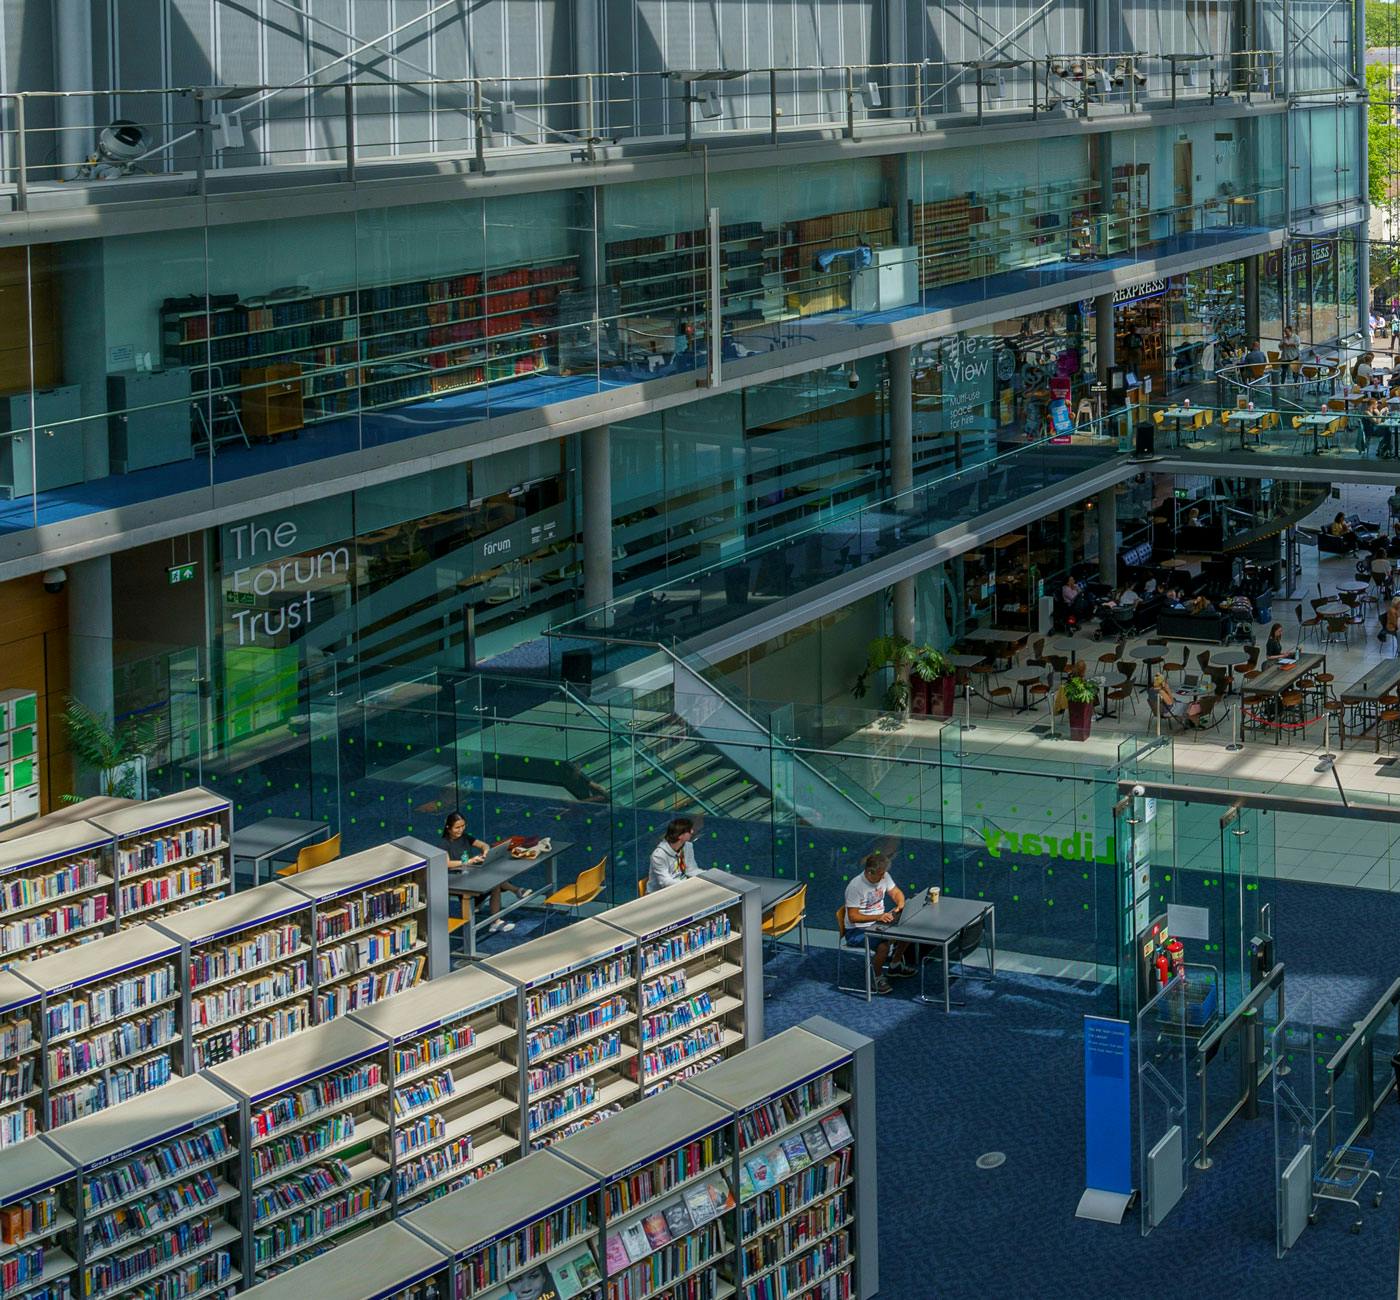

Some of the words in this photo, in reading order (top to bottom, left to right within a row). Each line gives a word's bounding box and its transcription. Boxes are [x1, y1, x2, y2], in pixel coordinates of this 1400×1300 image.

[949, 359, 989, 384] View
[229, 521, 298, 560] The
[483, 538, 511, 557] forum
[232, 546, 350, 597] Forum
[231, 590, 316, 646] Trust
